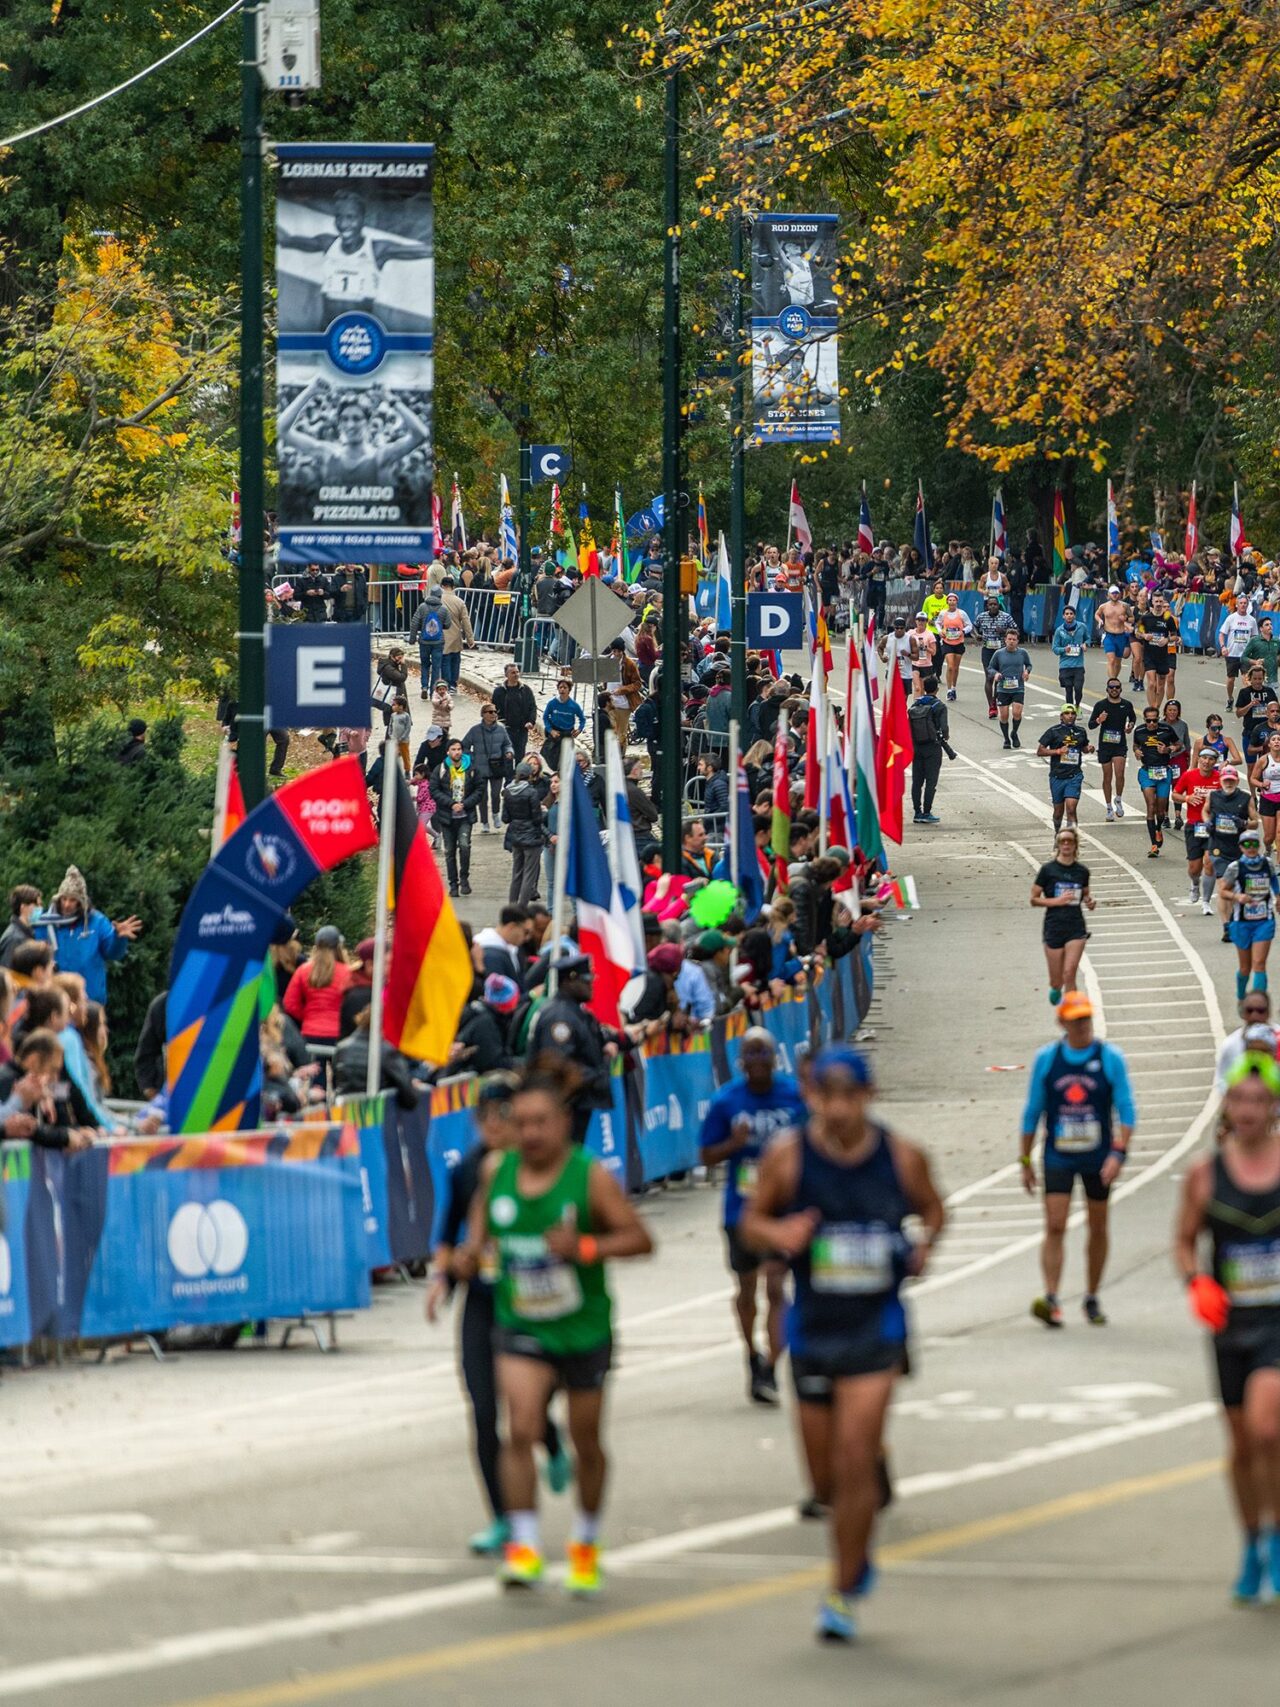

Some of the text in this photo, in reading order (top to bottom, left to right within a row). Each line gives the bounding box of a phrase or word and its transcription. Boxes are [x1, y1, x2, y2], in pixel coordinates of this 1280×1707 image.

[281, 162, 428, 178] LORNAH KIPLAGAT
[771, 224, 818, 232] ROD DIXON
[540, 452, 561, 476] C
[318, 486, 395, 501] ORLANDO
[312, 505, 401, 521] PIZZOLATO
[291, 535, 422, 546] NEW YORK ROAD RUNNERS
[760, 605, 790, 637] D
[296, 646, 346, 706] E
[172, 1273, 249, 1298] mastercard
